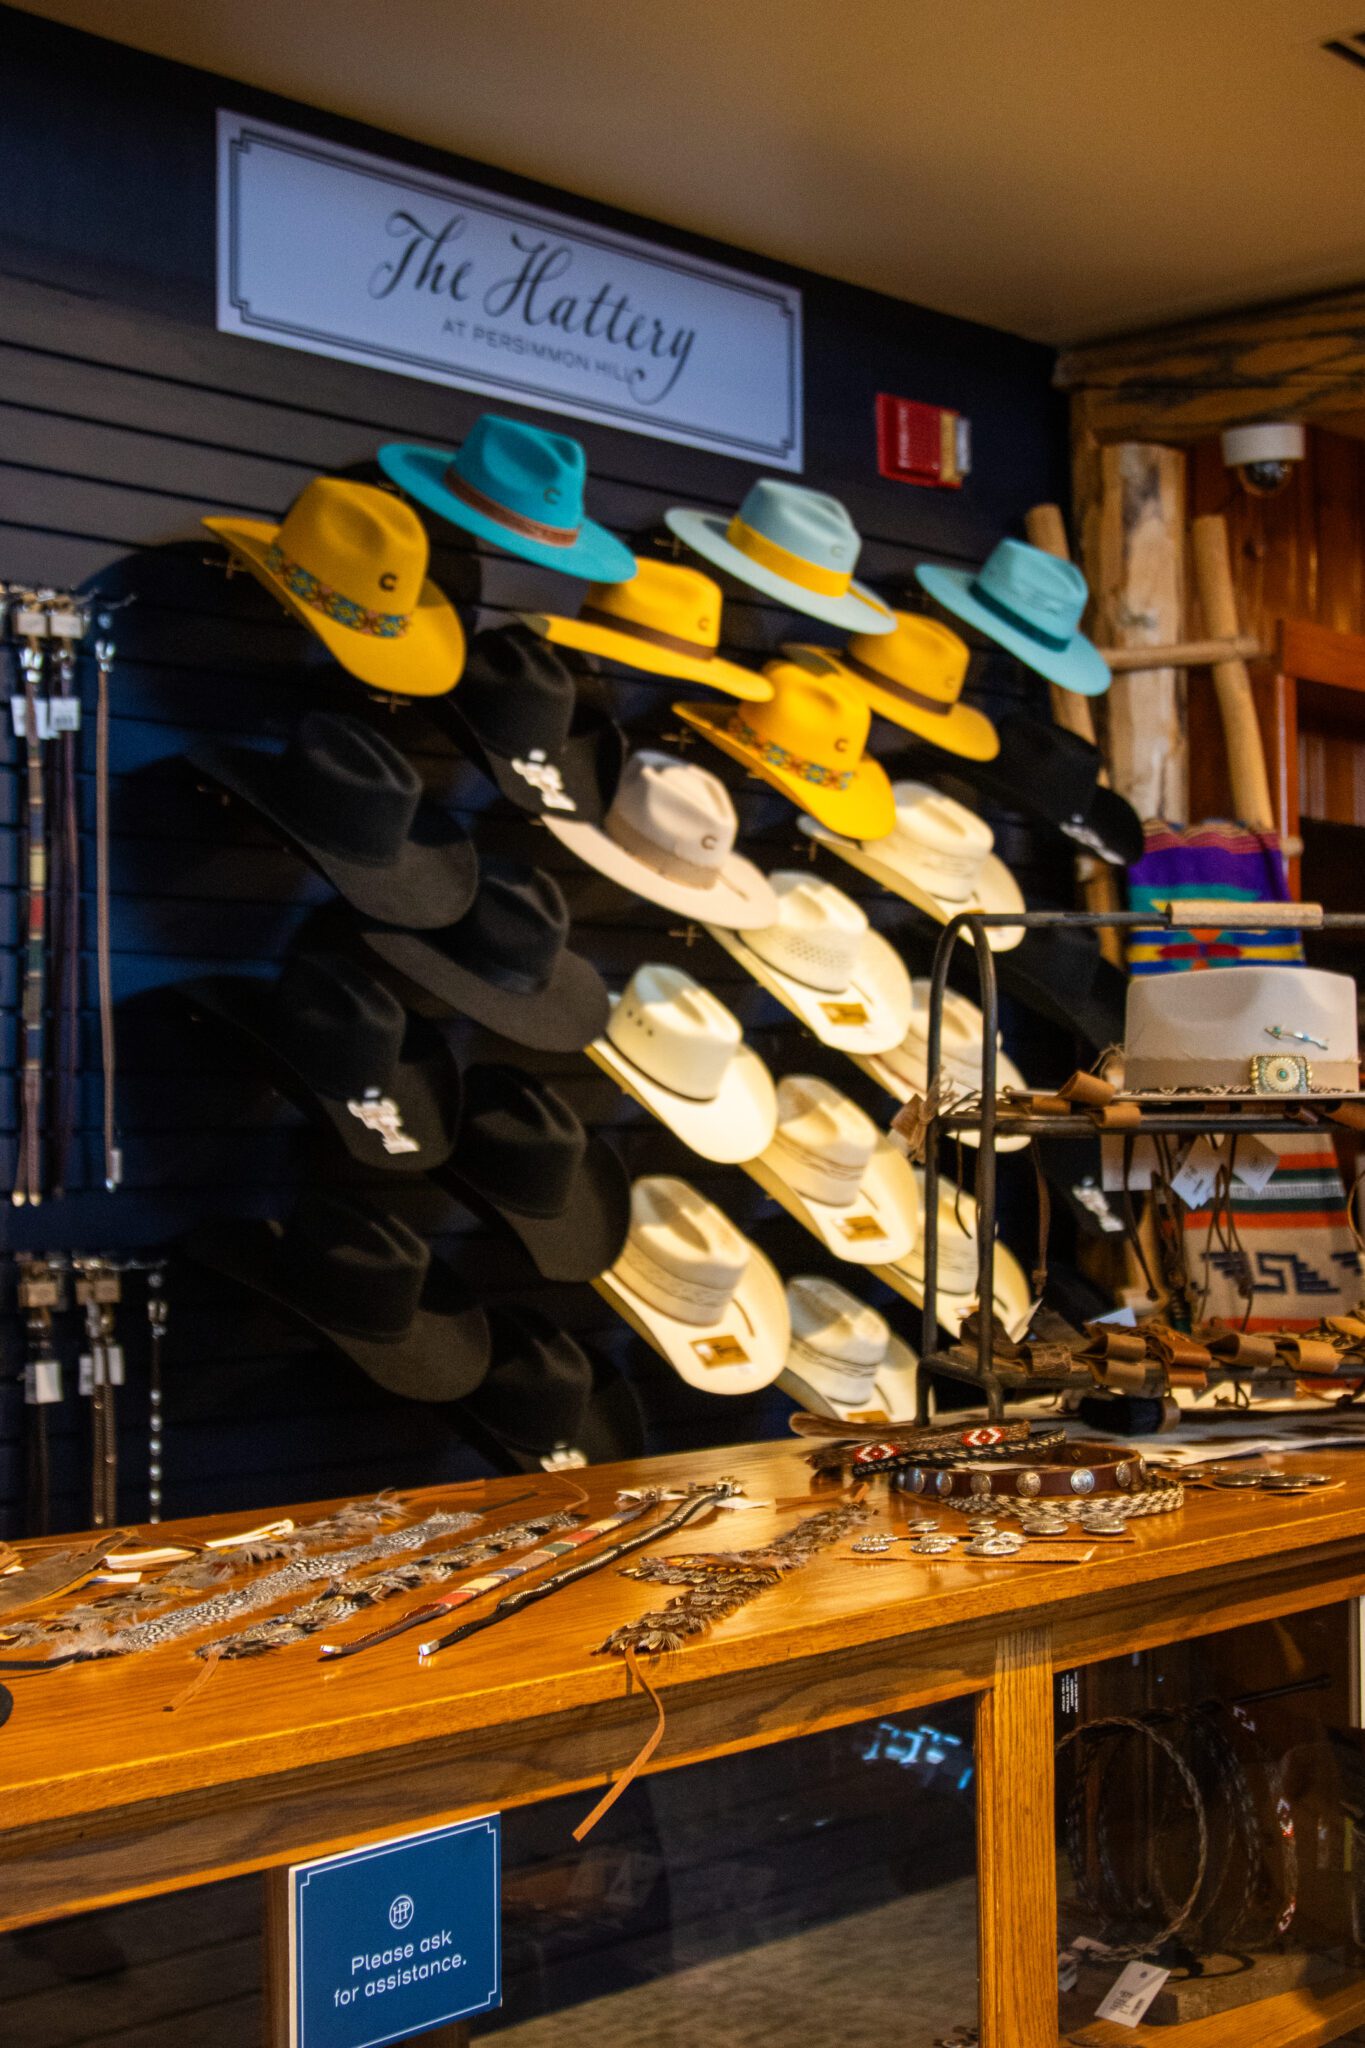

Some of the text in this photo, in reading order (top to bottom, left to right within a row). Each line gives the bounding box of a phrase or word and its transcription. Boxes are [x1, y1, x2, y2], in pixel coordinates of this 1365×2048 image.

[368, 209, 695, 406] The Hattery
[441, 318, 466, 337] AT
[472, 325, 591, 371] PERSIMMON
[351, 1929, 453, 1975] Please ask
[334, 1953, 467, 2008] for assistance.
